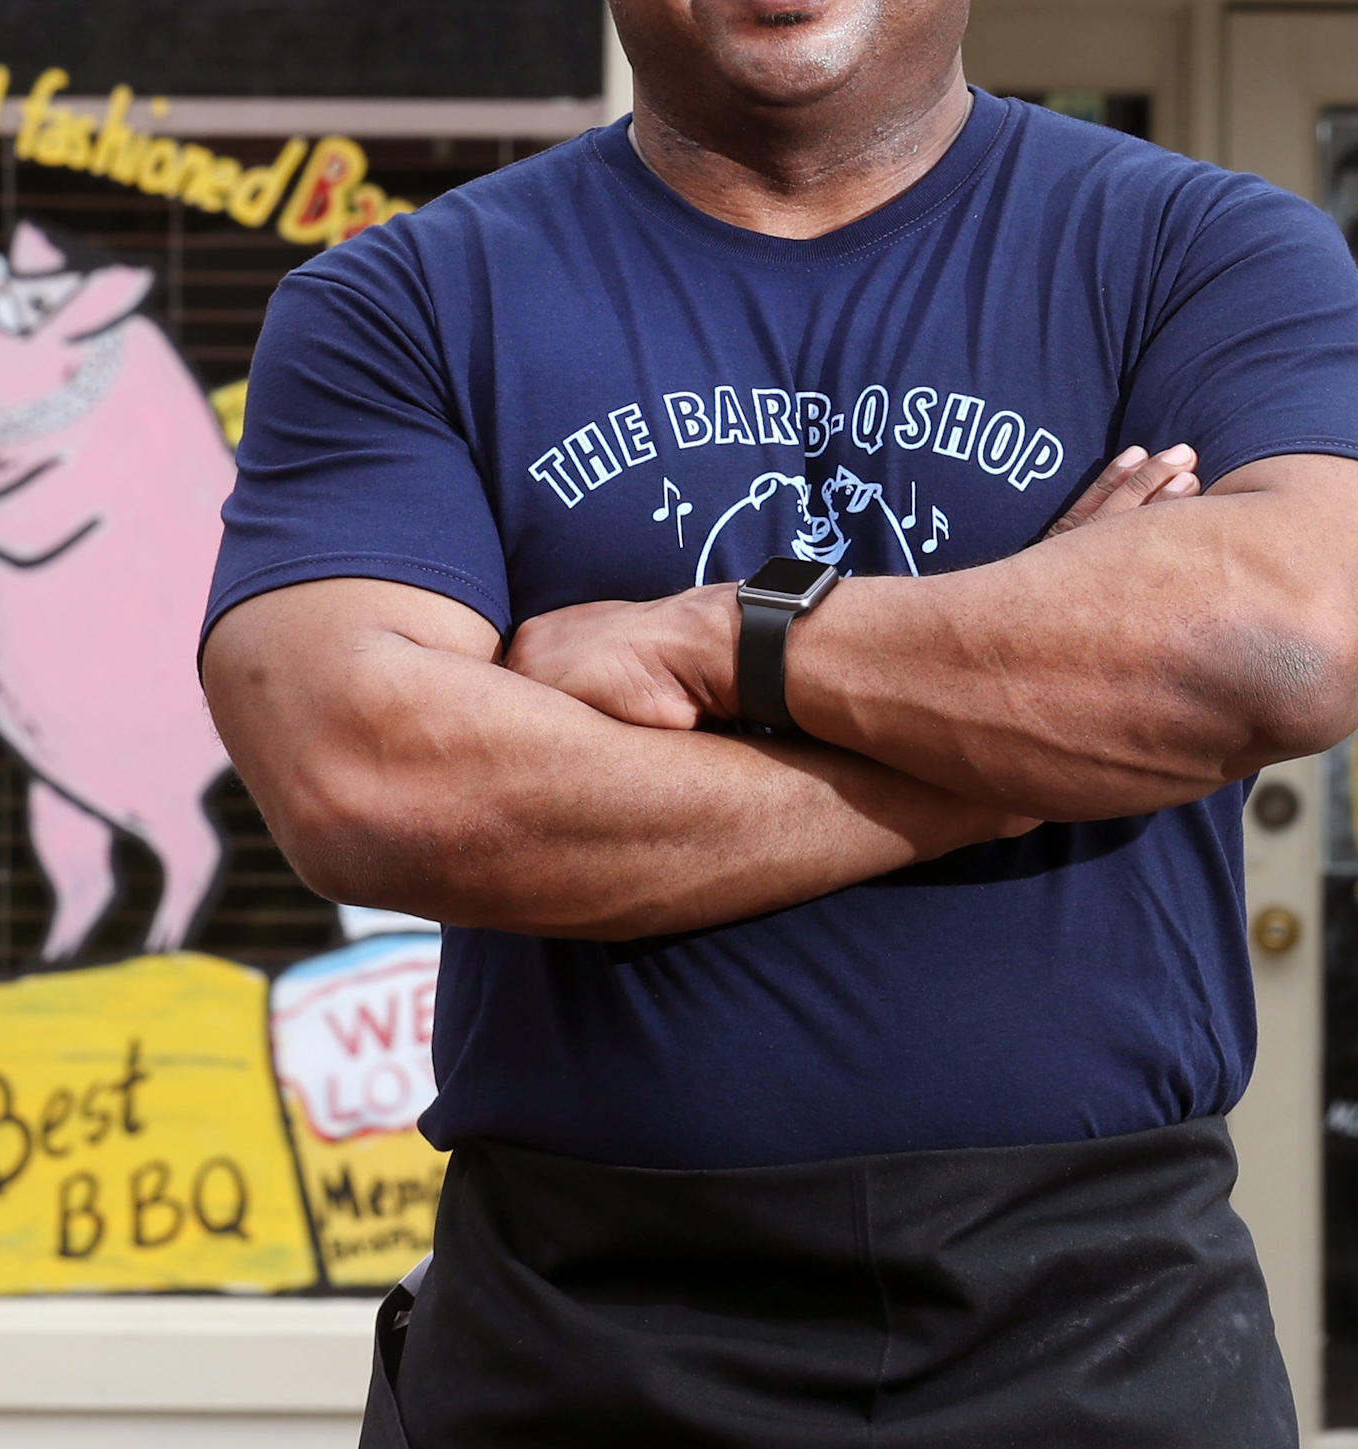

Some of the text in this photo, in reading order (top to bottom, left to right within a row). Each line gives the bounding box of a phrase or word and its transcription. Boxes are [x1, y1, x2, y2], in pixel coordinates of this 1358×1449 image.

[16, 67, 308, 229] fashioned
[528, 402, 657, 509] THE
[893, 385, 1065, 492] SHOP
[55, 1154, 252, 1261] BBQ
